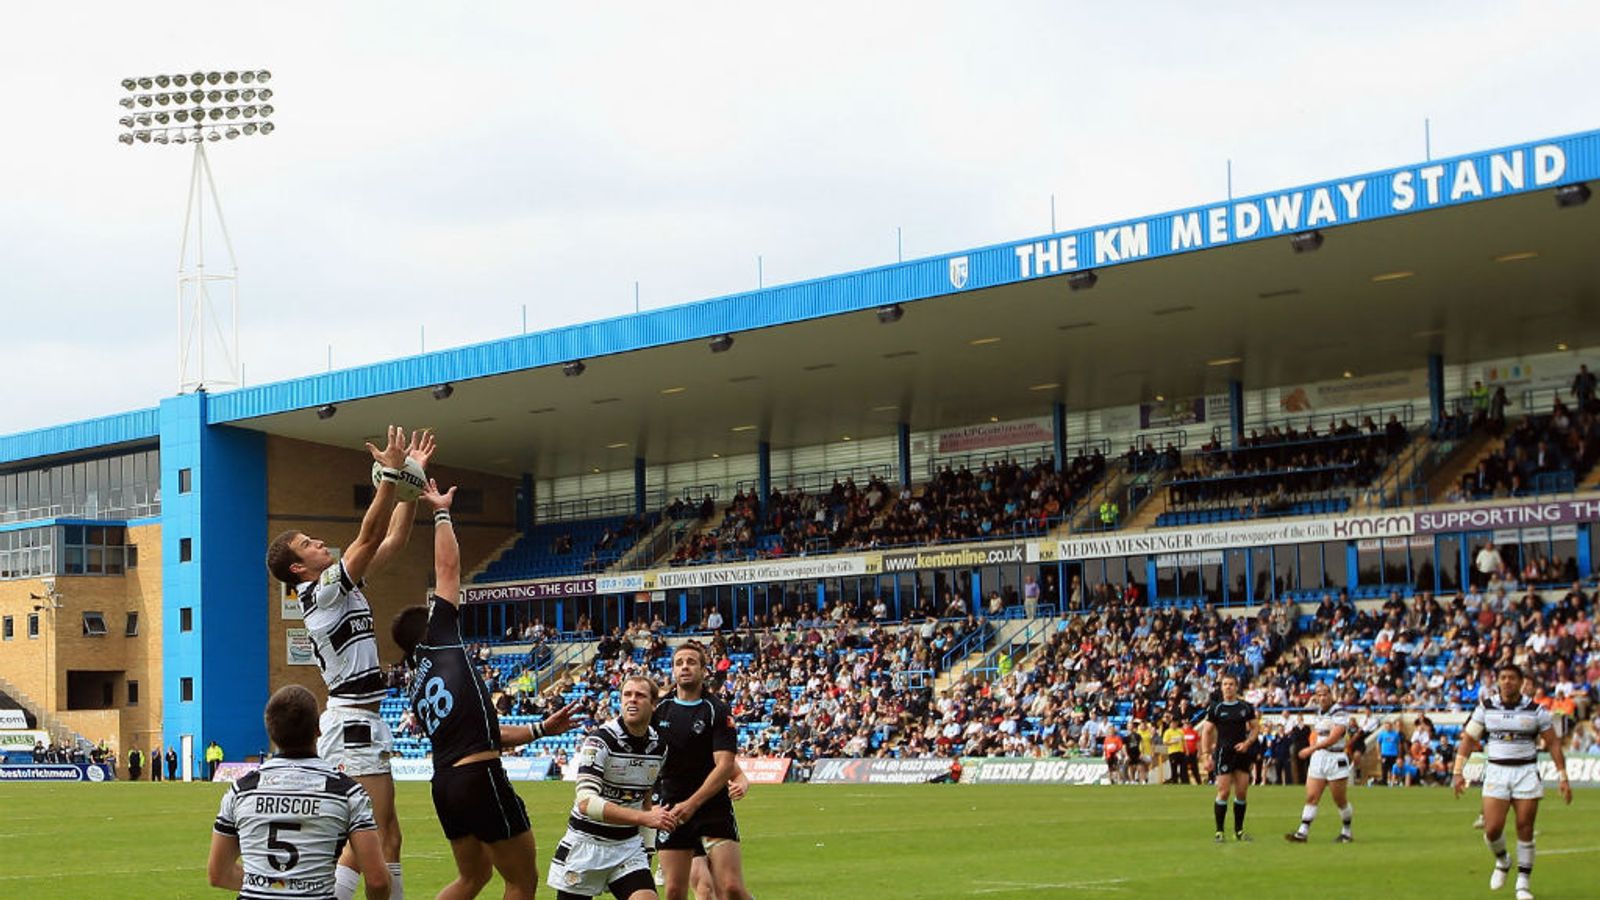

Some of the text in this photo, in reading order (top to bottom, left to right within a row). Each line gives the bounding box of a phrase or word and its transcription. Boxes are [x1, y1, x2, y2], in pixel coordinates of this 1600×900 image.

[1016, 145, 1566, 277] THE KM MEDWAY STAND
[1420, 504, 1561, 531] SUPPORTING
[1062, 523, 1329, 557] MEDWAY MESSENGER Official newspaper of the Gills
[885, 546, 1023, 571] www.kentonline.co.uk
[660, 573, 698, 586] MEDWAY
[700, 568, 756, 583] MESSENGER
[468, 586, 536, 601] SUPPORTING
[540, 583, 561, 595] THE
[564, 580, 594, 594] GILLS
[417, 676, 454, 735] 28
[980, 763, 1033, 780] HEINZ
[1028, 760, 1068, 781] BIG
[255, 796, 320, 816] BRISCOE
[268, 821, 301, 871] 5
